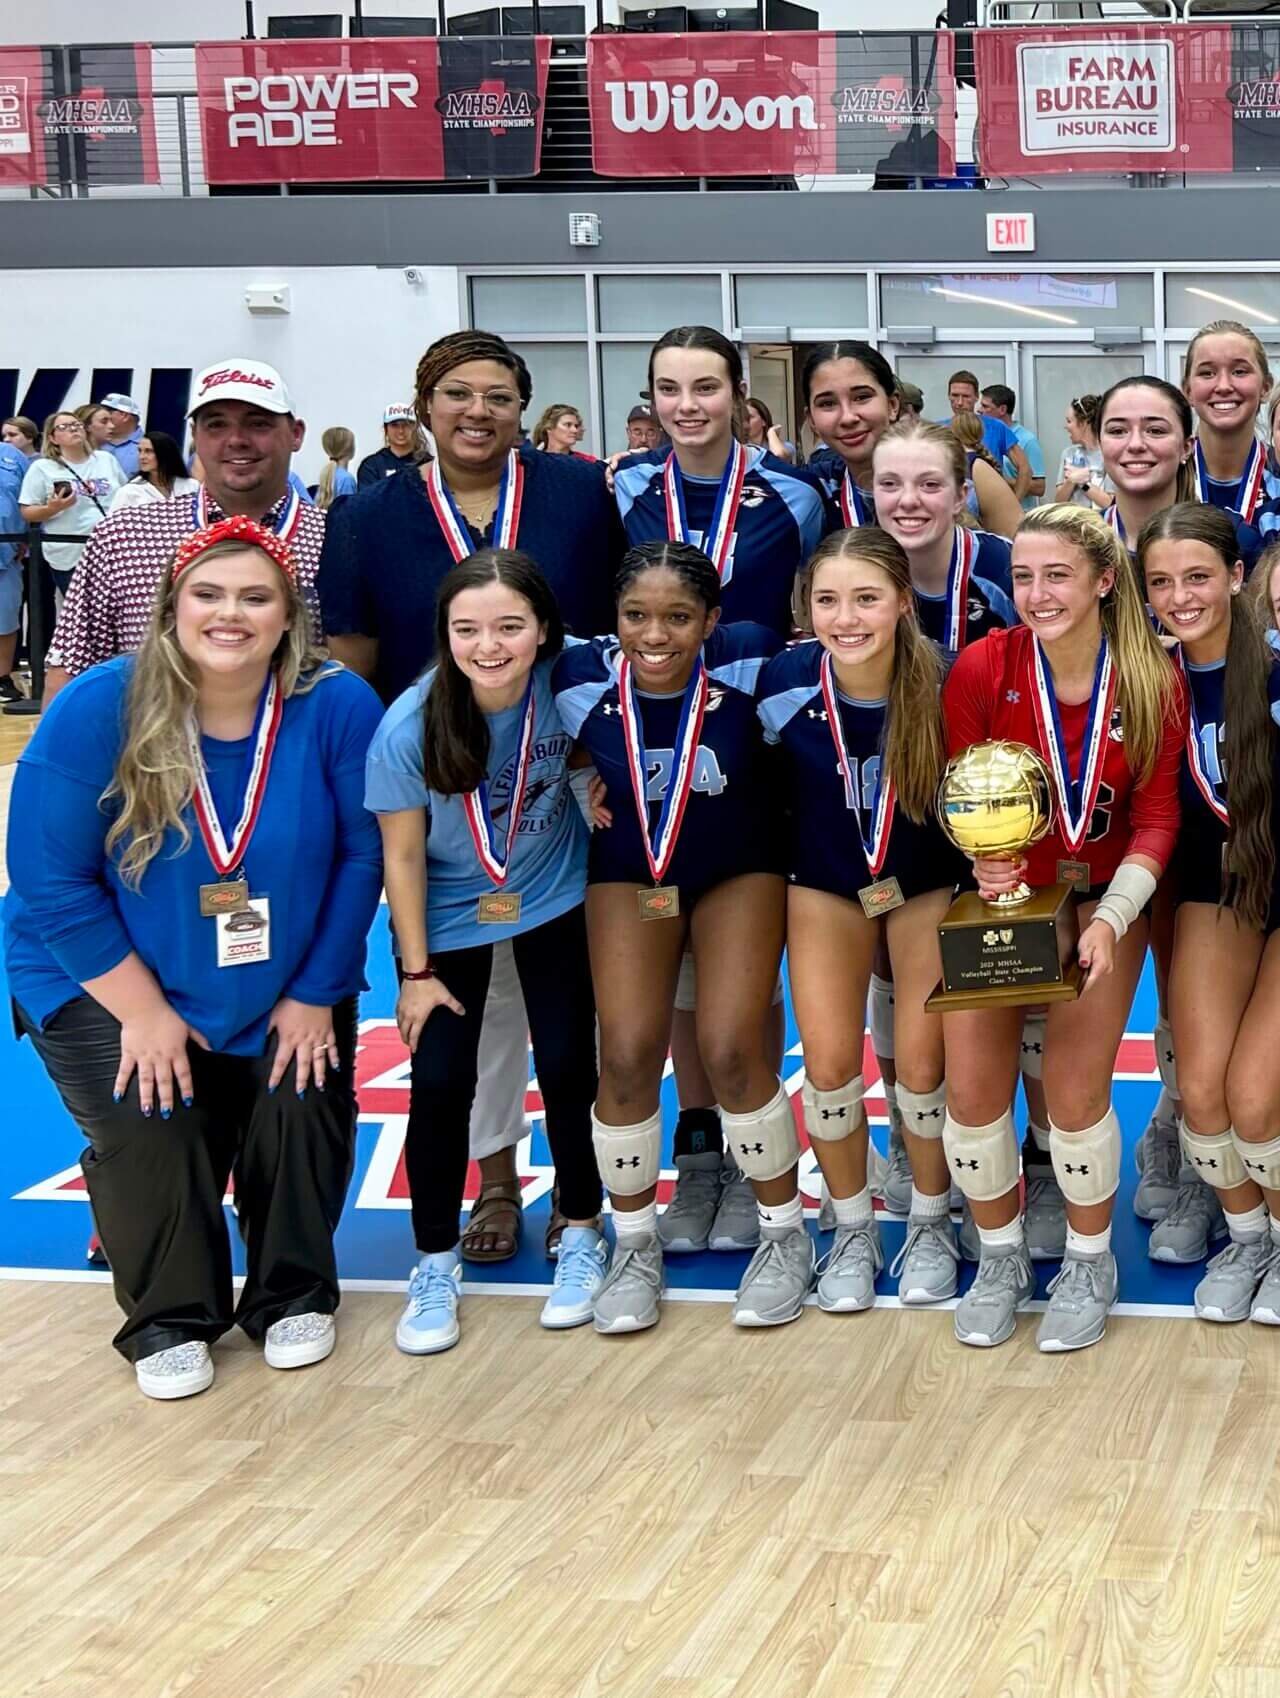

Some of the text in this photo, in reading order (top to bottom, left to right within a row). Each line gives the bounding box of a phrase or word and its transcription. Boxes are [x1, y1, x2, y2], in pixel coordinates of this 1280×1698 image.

[1068, 57, 1156, 82] FARM
[223, 72, 419, 112] POWER
[446, 91, 532, 118] MHSAA
[842, 87, 930, 114] MHSAA
[1036, 85, 1158, 113] BUREAU
[46, 98, 132, 124] MHSAA
[604, 78, 820, 133] Wilson
[1234, 109, 1263, 119] STATE
[44, 125, 138, 135] STATE CHAMPIONSHIPS
[443, 118, 535, 129] STATE CHAMPIONSHIPS
[837, 114, 936, 125] STATE CHAMPIONSHIPS
[1057, 121, 1158, 137] INSURANCE
[994, 218, 1027, 245] EXIT
[198, 368, 275, 397] Titleist
[645, 744, 728, 801] 24
[982, 945, 1016, 954] MISSISSIPPI
[961, 965, 1043, 979] Volleyball State Champion
[998, 959, 1022, 968] MHSAA
